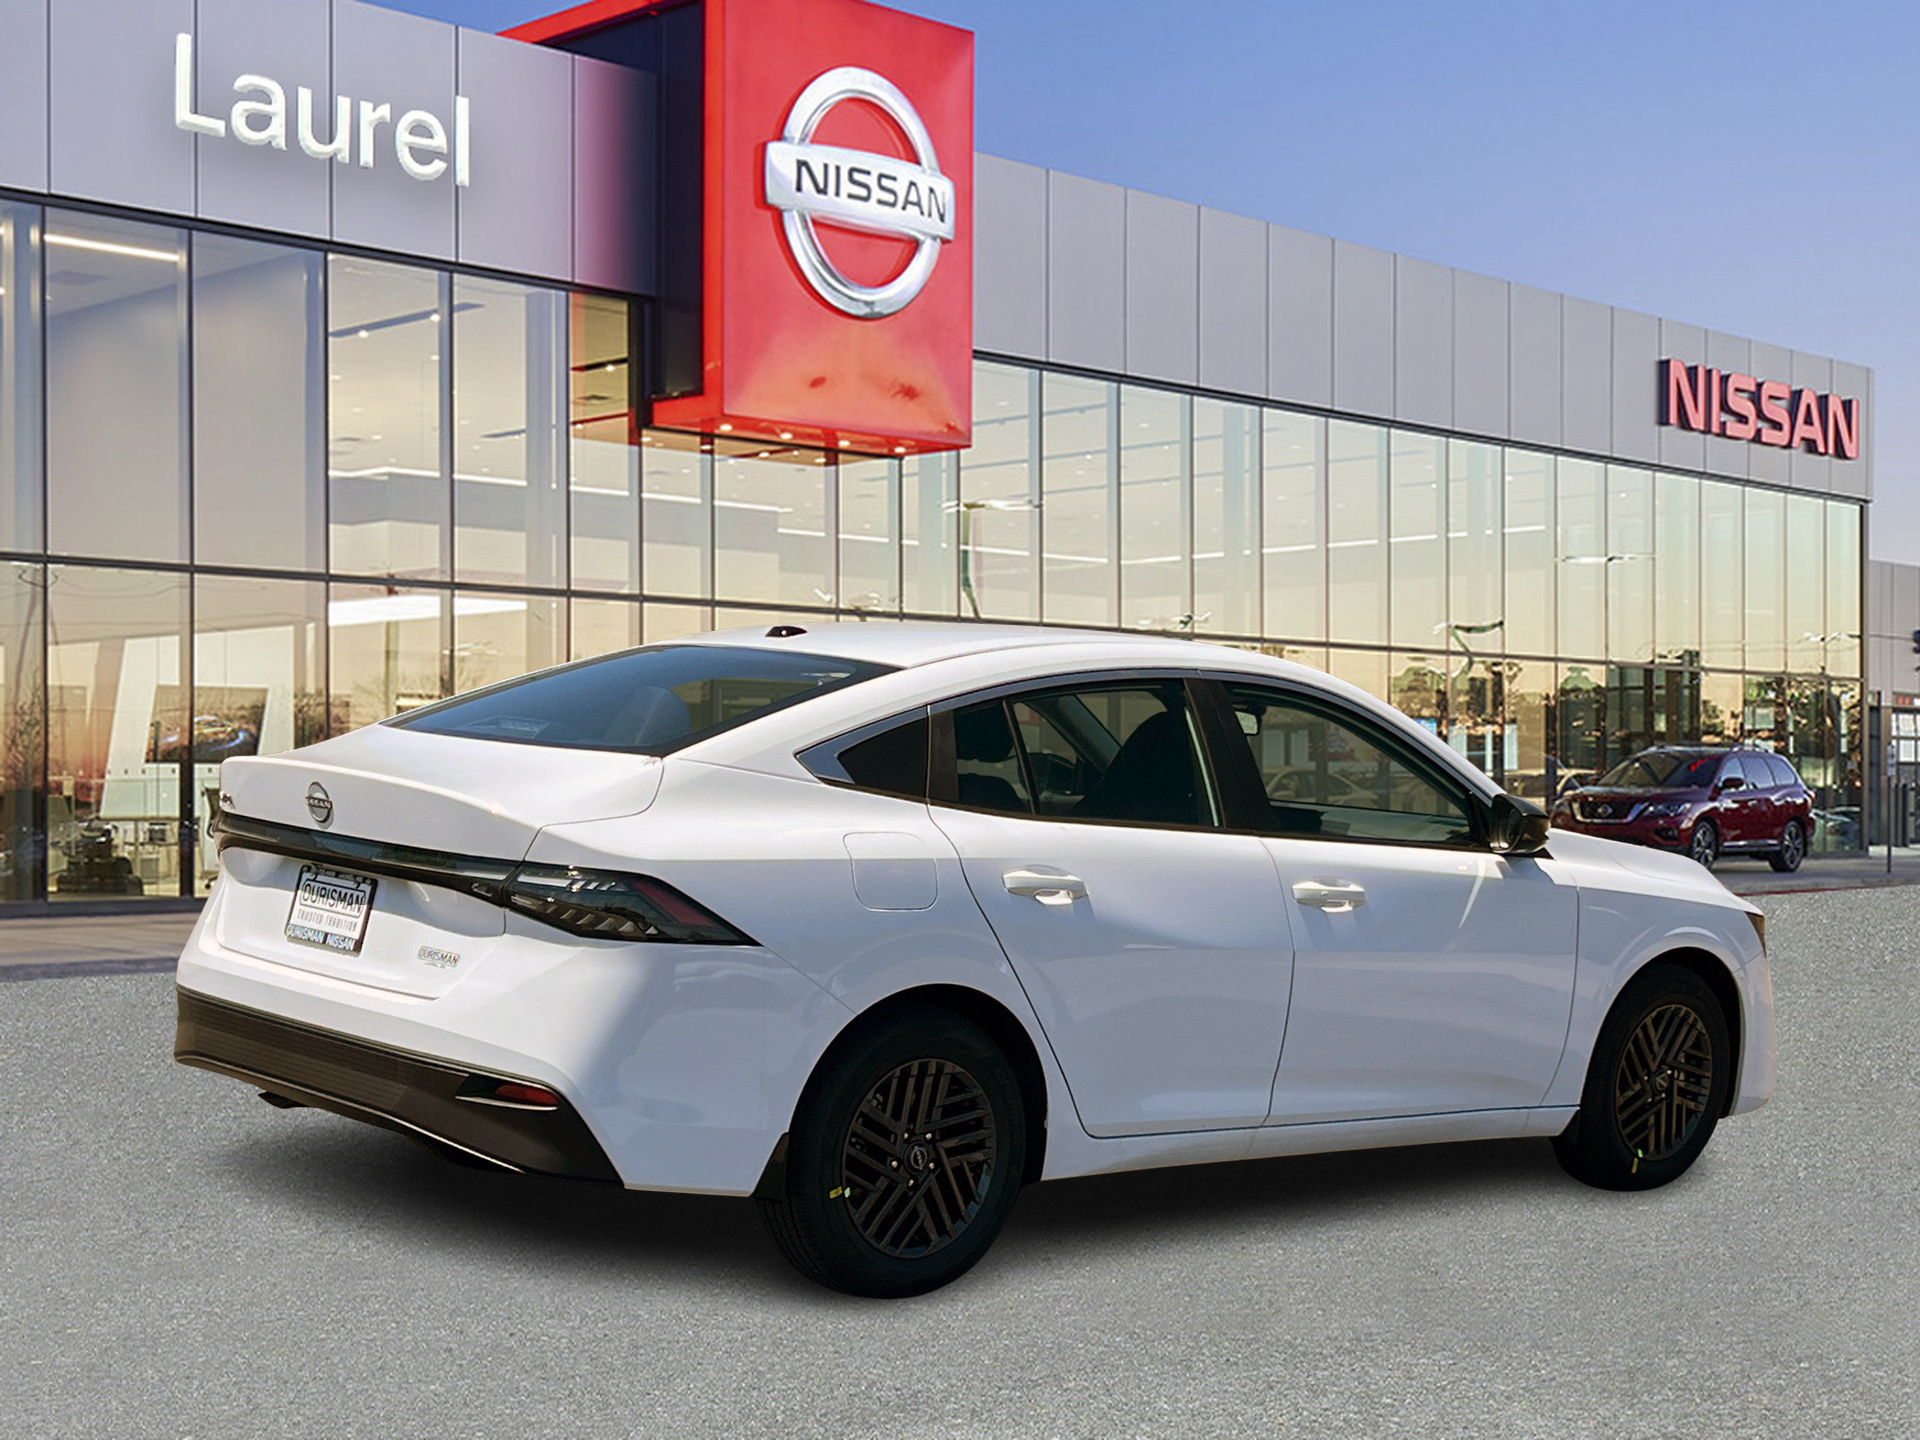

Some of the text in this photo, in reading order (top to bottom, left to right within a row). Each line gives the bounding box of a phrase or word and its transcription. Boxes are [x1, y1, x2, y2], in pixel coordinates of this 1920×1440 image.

[174, 32, 470, 187] Laurel
[795, 158, 946, 224] NISSAN
[1657, 358, 1860, 460] NISSAN
[302, 882, 366, 915] OURISMAN
[326, 933, 356, 951] NISSAN
